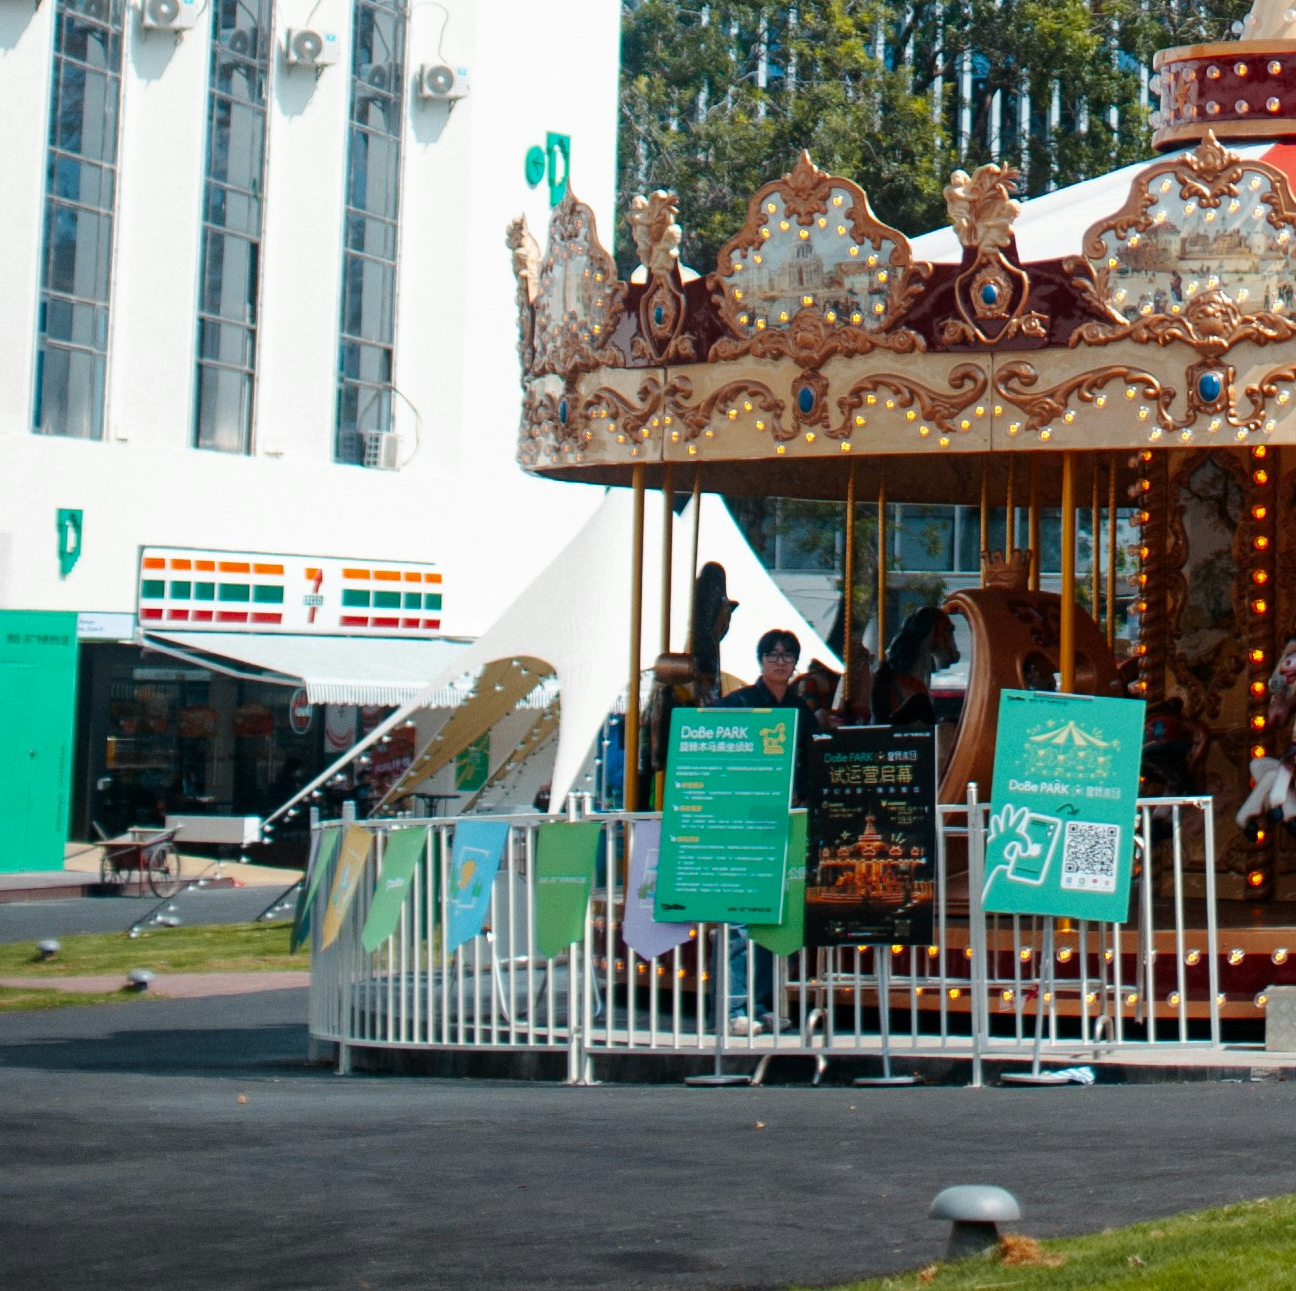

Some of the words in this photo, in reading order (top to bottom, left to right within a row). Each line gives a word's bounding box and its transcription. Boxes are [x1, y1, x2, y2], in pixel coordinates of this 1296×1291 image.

[681, 725, 714, 740] DoBe
[715, 726, 748, 739] PARK
[849, 752, 873, 762] PARK
[829, 764, 913, 784] 试运营启幕
[1008, 779, 1038, 792] DoBe
[1039, 782, 1070, 795] PARK
